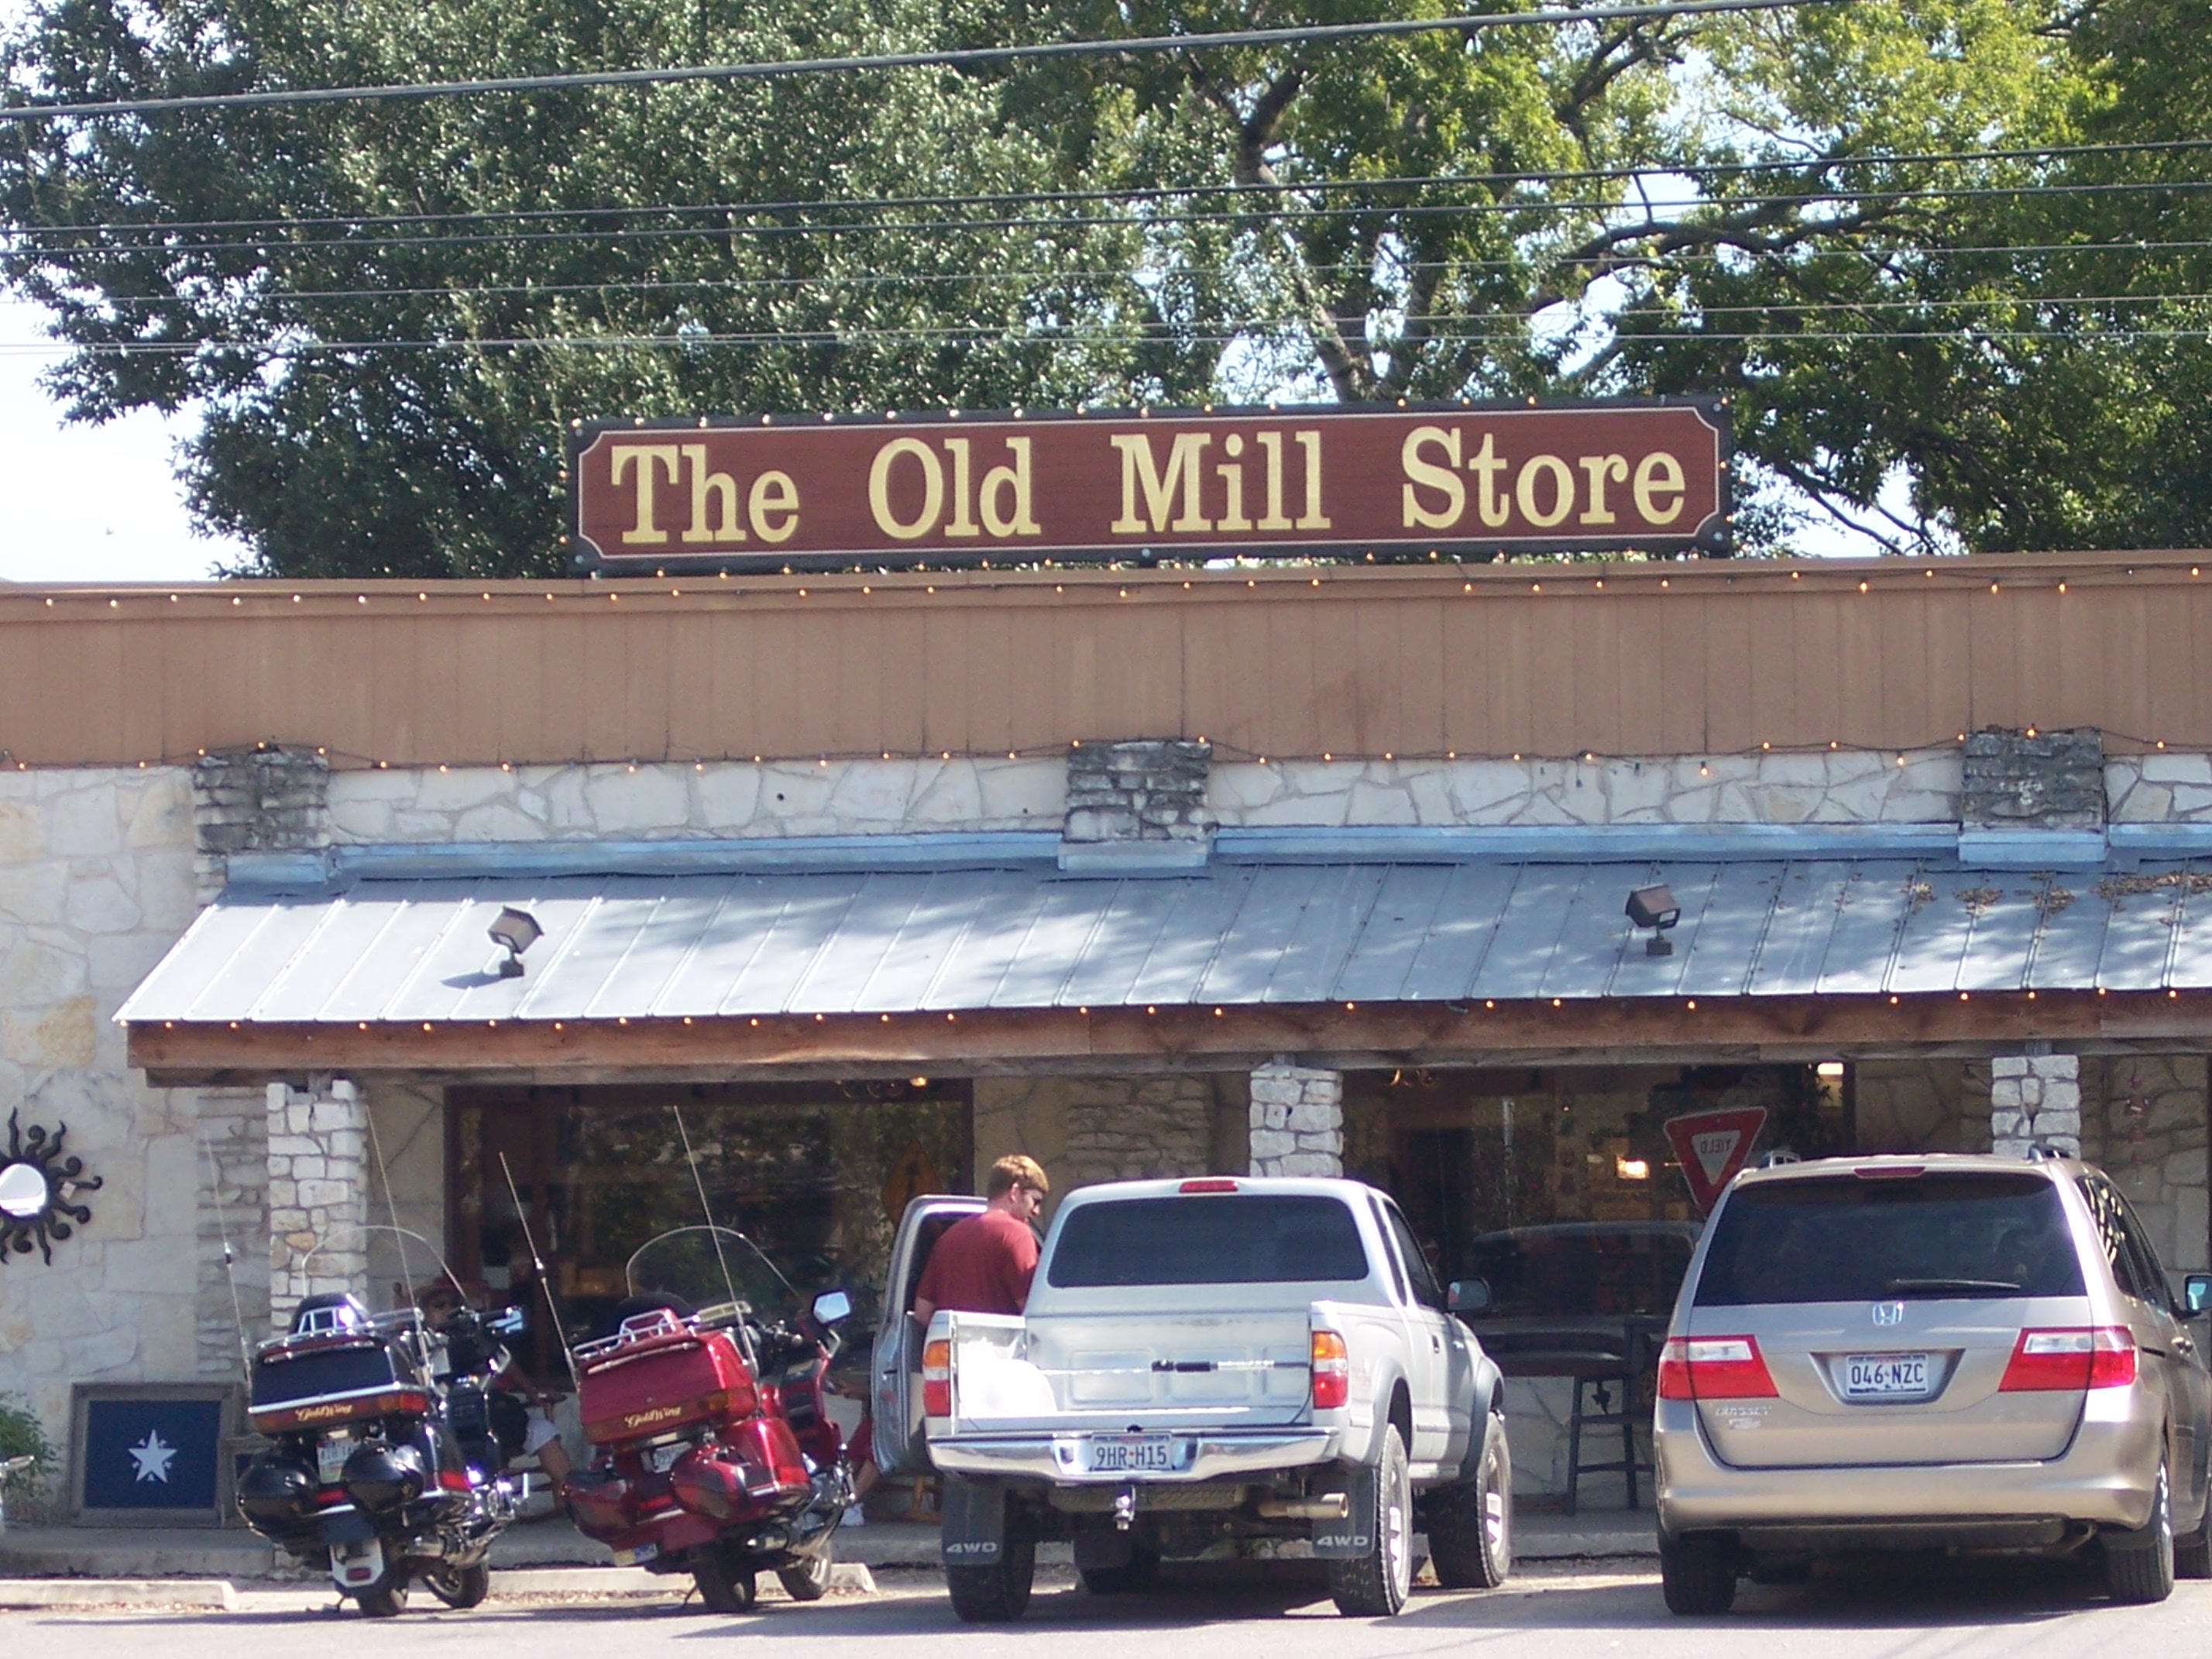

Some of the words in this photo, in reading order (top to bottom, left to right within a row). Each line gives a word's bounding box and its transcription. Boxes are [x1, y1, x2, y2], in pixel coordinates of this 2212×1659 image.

[610, 444, 799, 543] The
[868, 436, 1042, 540] Old
[1110, 430, 1331, 534] Mill
[1401, 425, 1687, 530] Store
[946, 1541, 998, 1554] 4WD
[1317, 1535, 1369, 1547] 4WD
